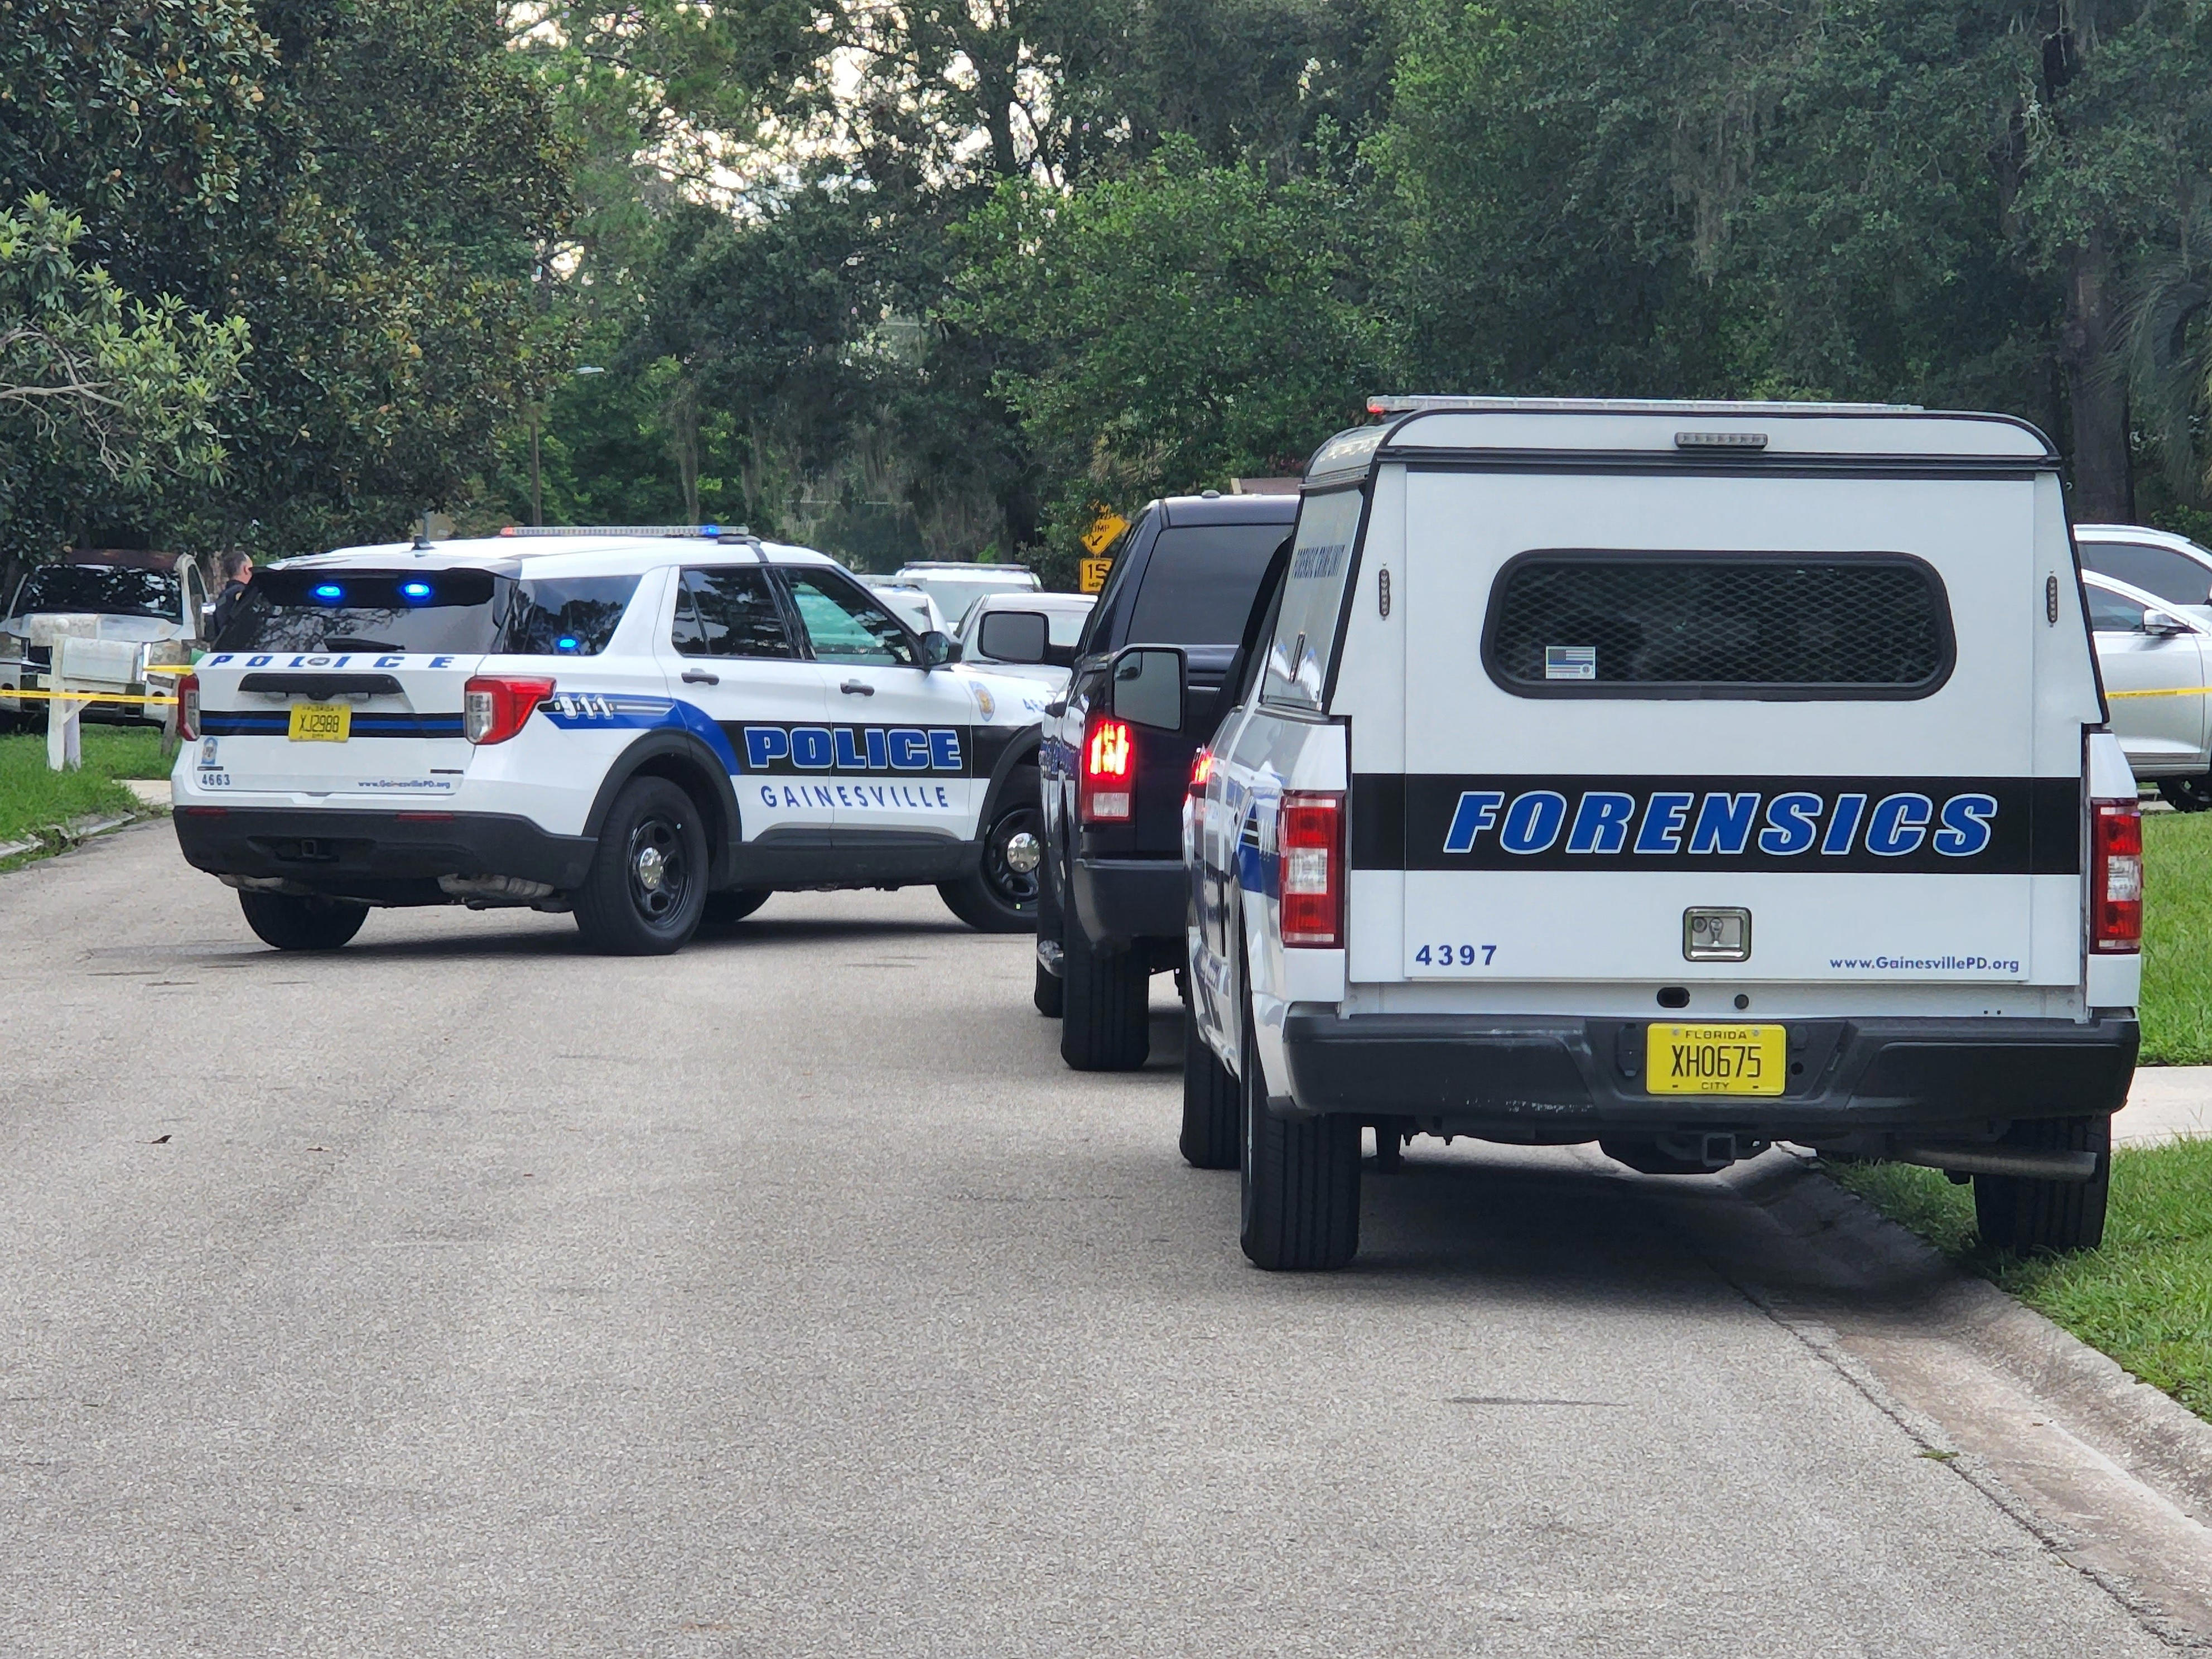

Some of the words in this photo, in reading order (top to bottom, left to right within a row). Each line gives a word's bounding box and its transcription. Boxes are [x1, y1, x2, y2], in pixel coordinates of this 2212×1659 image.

[1088, 563, 1109, 579] 15
[209, 655, 455, 668] POLICE
[299, 714, 340, 733] XJ2988
[744, 726, 963, 770] POLICE
[202, 774, 230, 786] 4663
[760, 785, 950, 808] GAINESVILLE
[1443, 790, 1998, 856] FORENSICS
[1415, 944, 1497, 966] 4397
[1830, 956, 2020, 973] www.GainesvillePD.org
[1685, 1030, 1747, 1040] FLORIDA
[1671, 1045, 1762, 1078] XH0675
[1702, 1082, 1729, 1090] CITY
